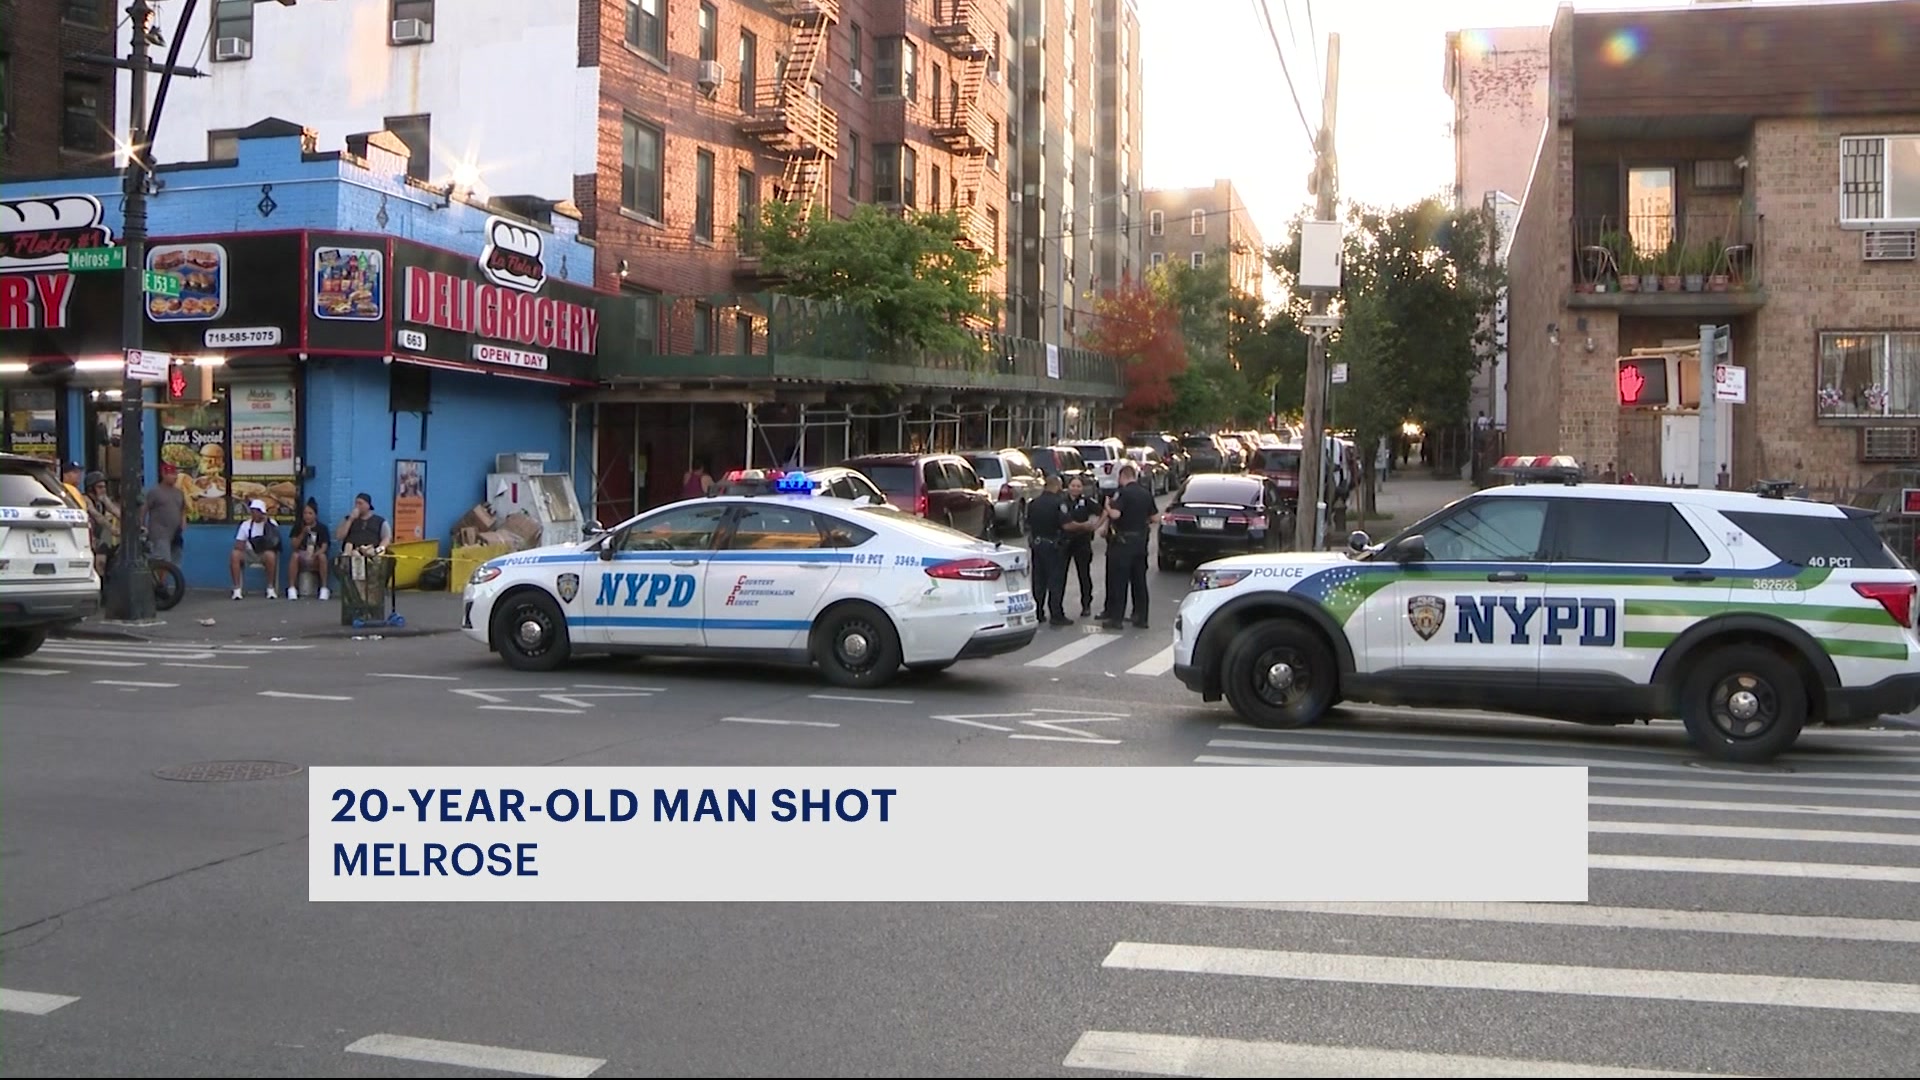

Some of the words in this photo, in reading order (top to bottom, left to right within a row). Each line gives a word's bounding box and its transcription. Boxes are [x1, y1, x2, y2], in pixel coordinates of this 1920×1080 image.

[71, 252, 110, 268] Melrose
[154, 275, 167, 292] 153
[407, 266, 475, 333] DELI
[478, 284, 599, 355] GROCERY
[208, 331, 274, 343] 718-585-7075
[406, 334, 422, 347] 663
[480, 347, 511, 363] OPEN
[514, 352, 521, 364] 7
[524, 354, 544, 367] DAY
[164, 430, 190, 443] Lunch
[191, 430, 224, 446] Special
[780, 480, 813, 489] NYPD
[506, 556, 540, 566] POLICE
[855, 554, 865, 564] 40
[868, 554, 884, 564] PCT
[894, 555, 915, 566] 3349
[1808, 557, 1825, 567] 40
[1829, 557, 1852, 568] PCT
[1253, 567, 1303, 578] POLICE
[596, 573, 696, 608] NYPD
[1454, 595, 1615, 646] NYPD
